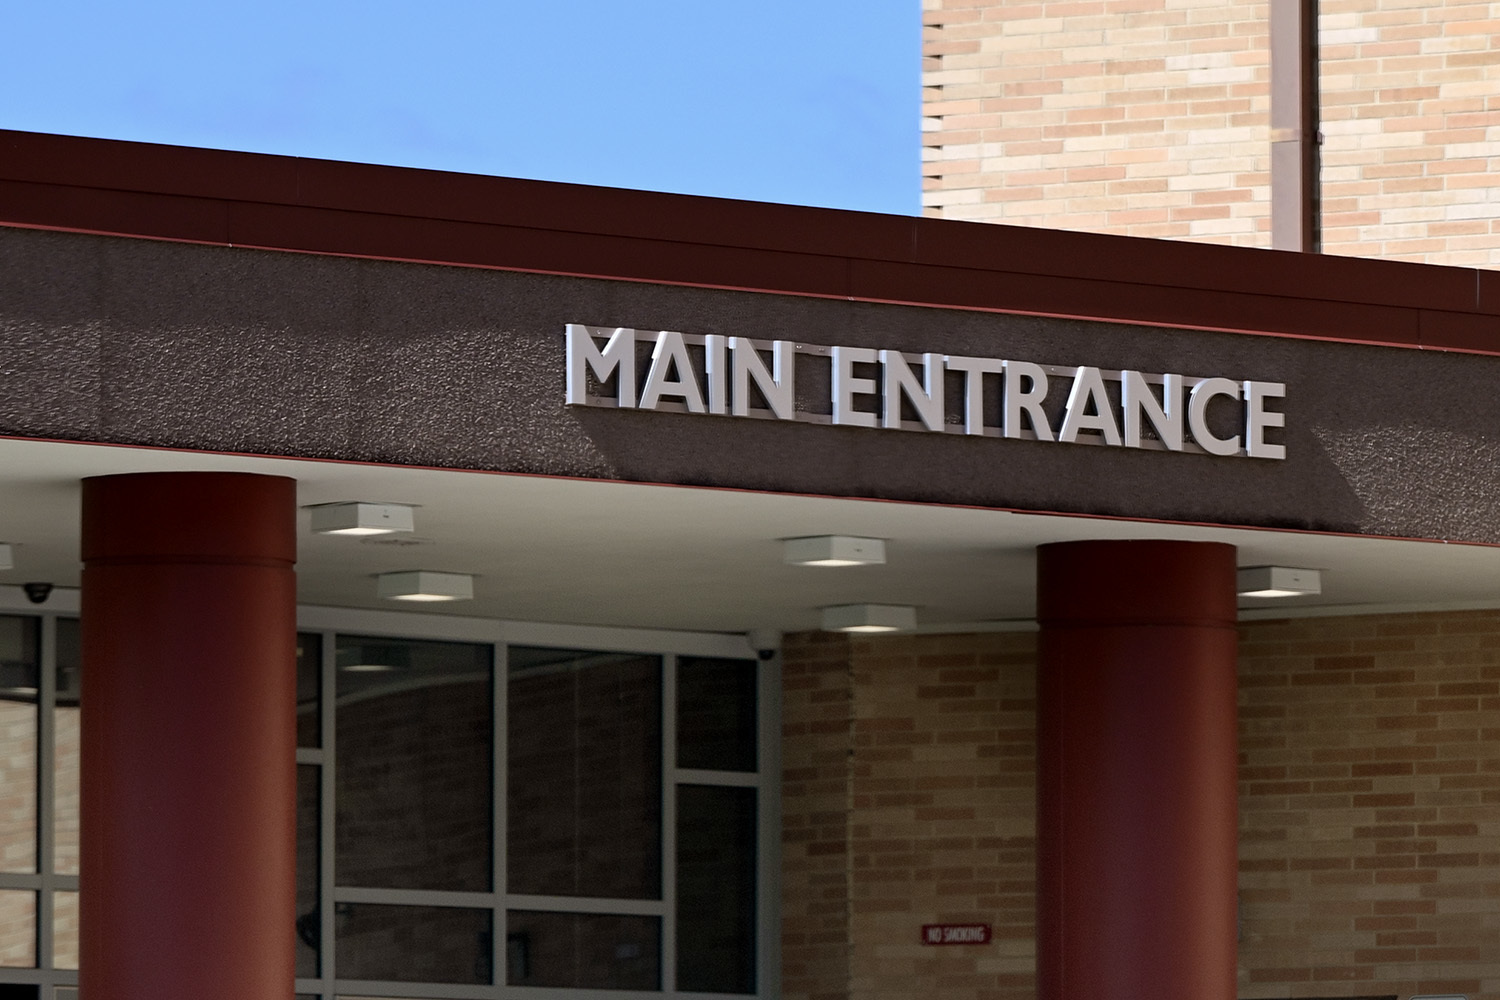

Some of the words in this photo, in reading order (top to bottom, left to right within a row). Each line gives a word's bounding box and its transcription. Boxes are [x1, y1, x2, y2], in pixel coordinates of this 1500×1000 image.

[565, 323, 795, 420] MAIN
[831, 345, 1287, 459] ENTRANCE
[928, 928, 942, 943] NO
[944, 926, 985, 942] SMOKING
